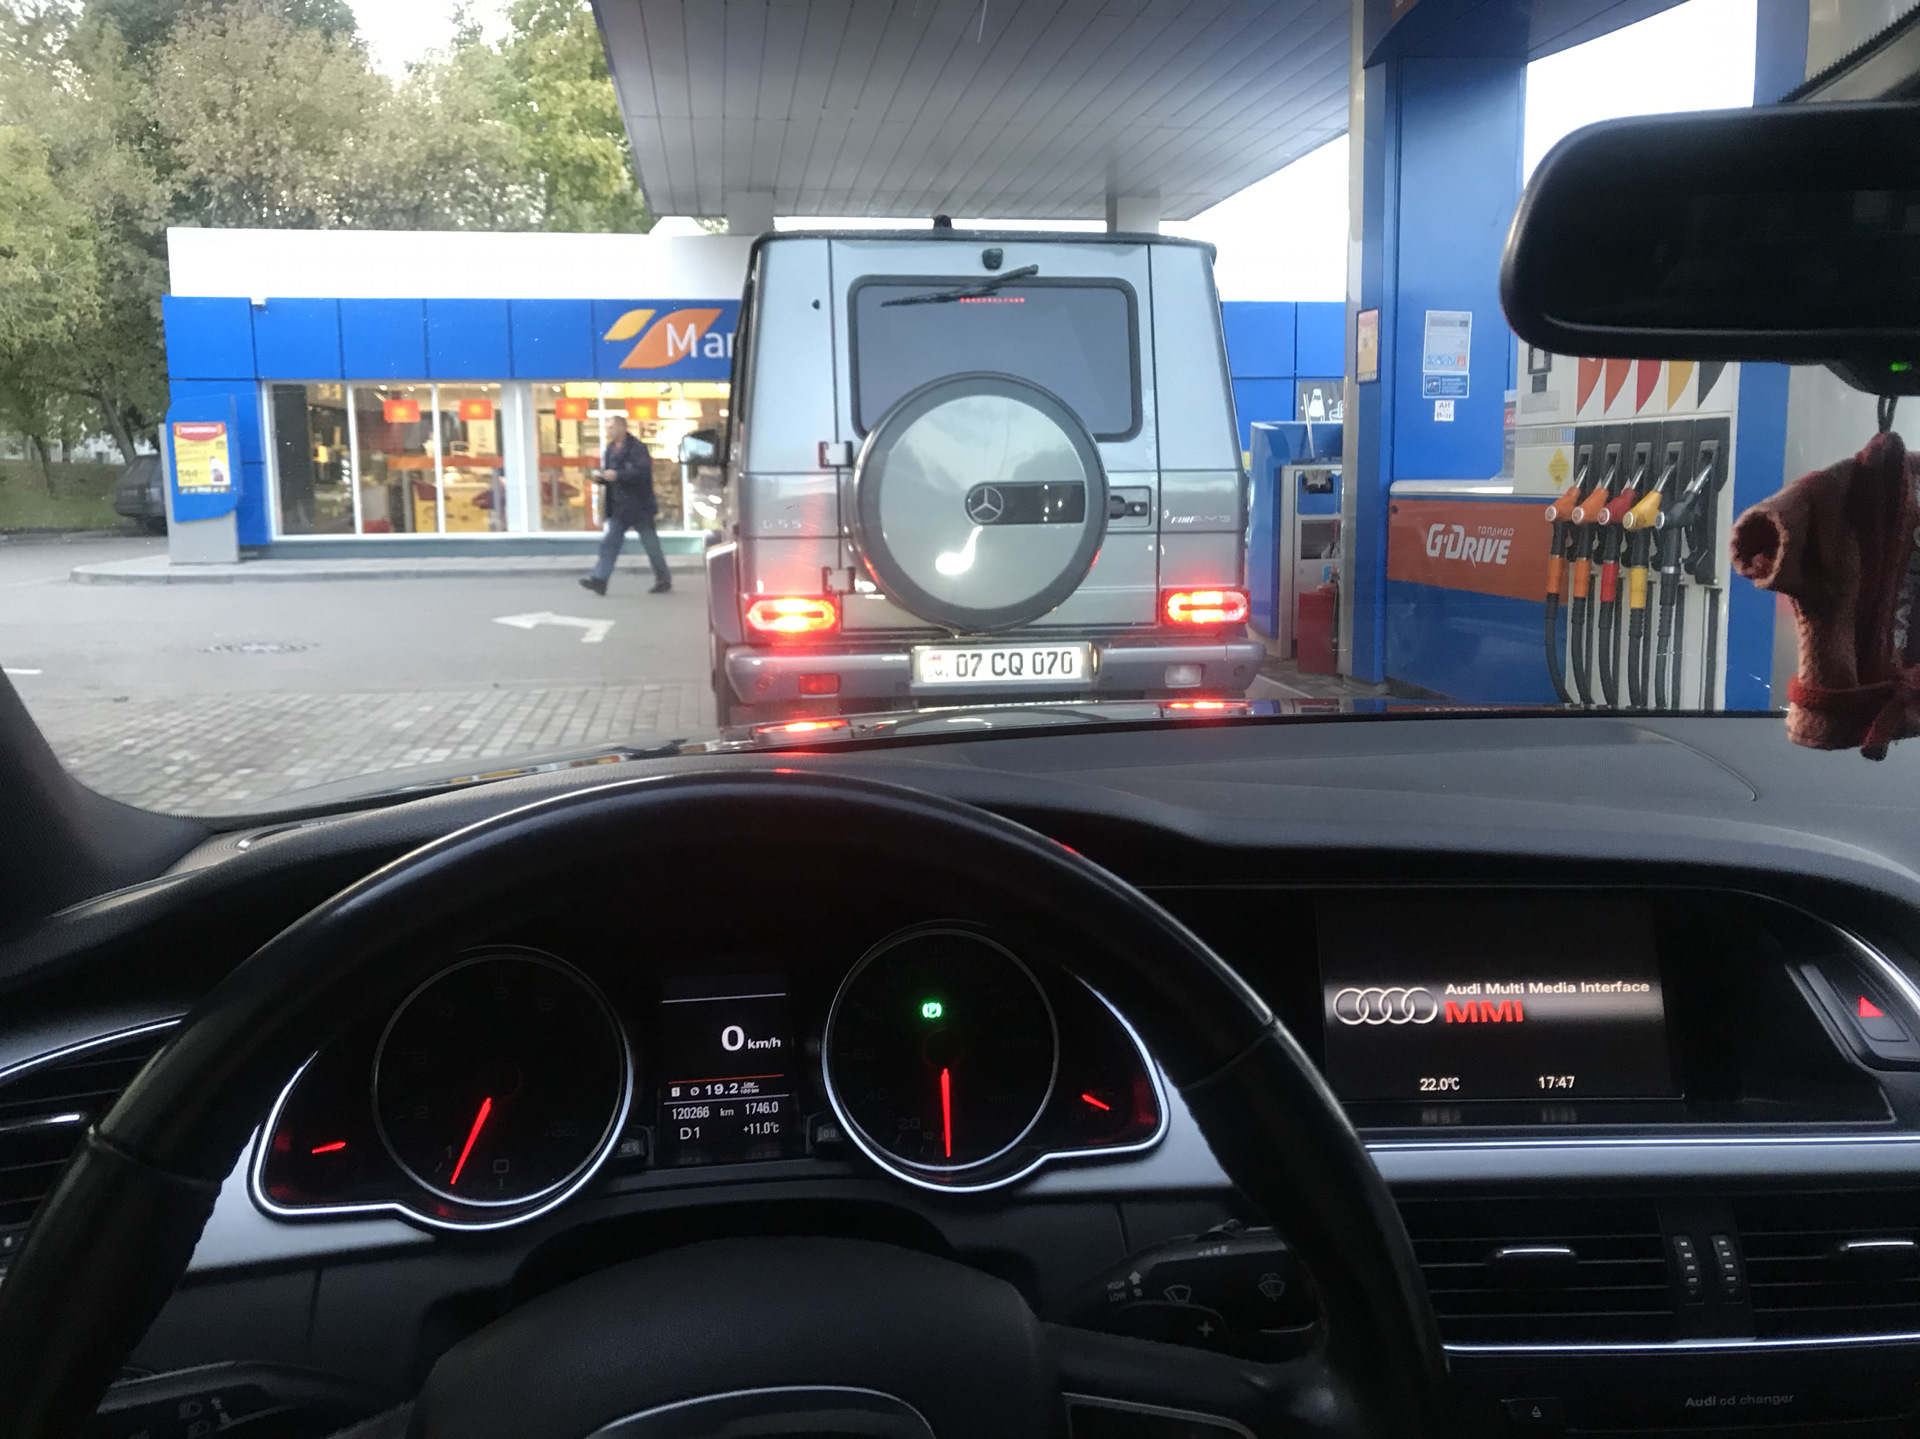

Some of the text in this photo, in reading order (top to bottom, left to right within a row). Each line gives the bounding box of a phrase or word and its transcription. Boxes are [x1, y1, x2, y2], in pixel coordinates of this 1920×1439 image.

[955, 651, 1073, 678] 07 CQ 070
[1445, 981, 1650, 995] Audi Multi Media Interface
[1445, 1000, 1524, 1023] MMI
[721, 1025, 782, 1051] 0 km/h
[1420, 1077, 1460, 1091] 22.0°C
[1538, 1075, 1575, 1089] 17:47
[705, 1083, 739, 1096] 19.2
[672, 1106, 710, 1120] 120266
[720, 1107, 735, 1117] km
[745, 1101, 779, 1115] 1746.0
[680, 1127, 700, 1140] D1
[1685, 1394, 1795, 1407] Audi cd changer
